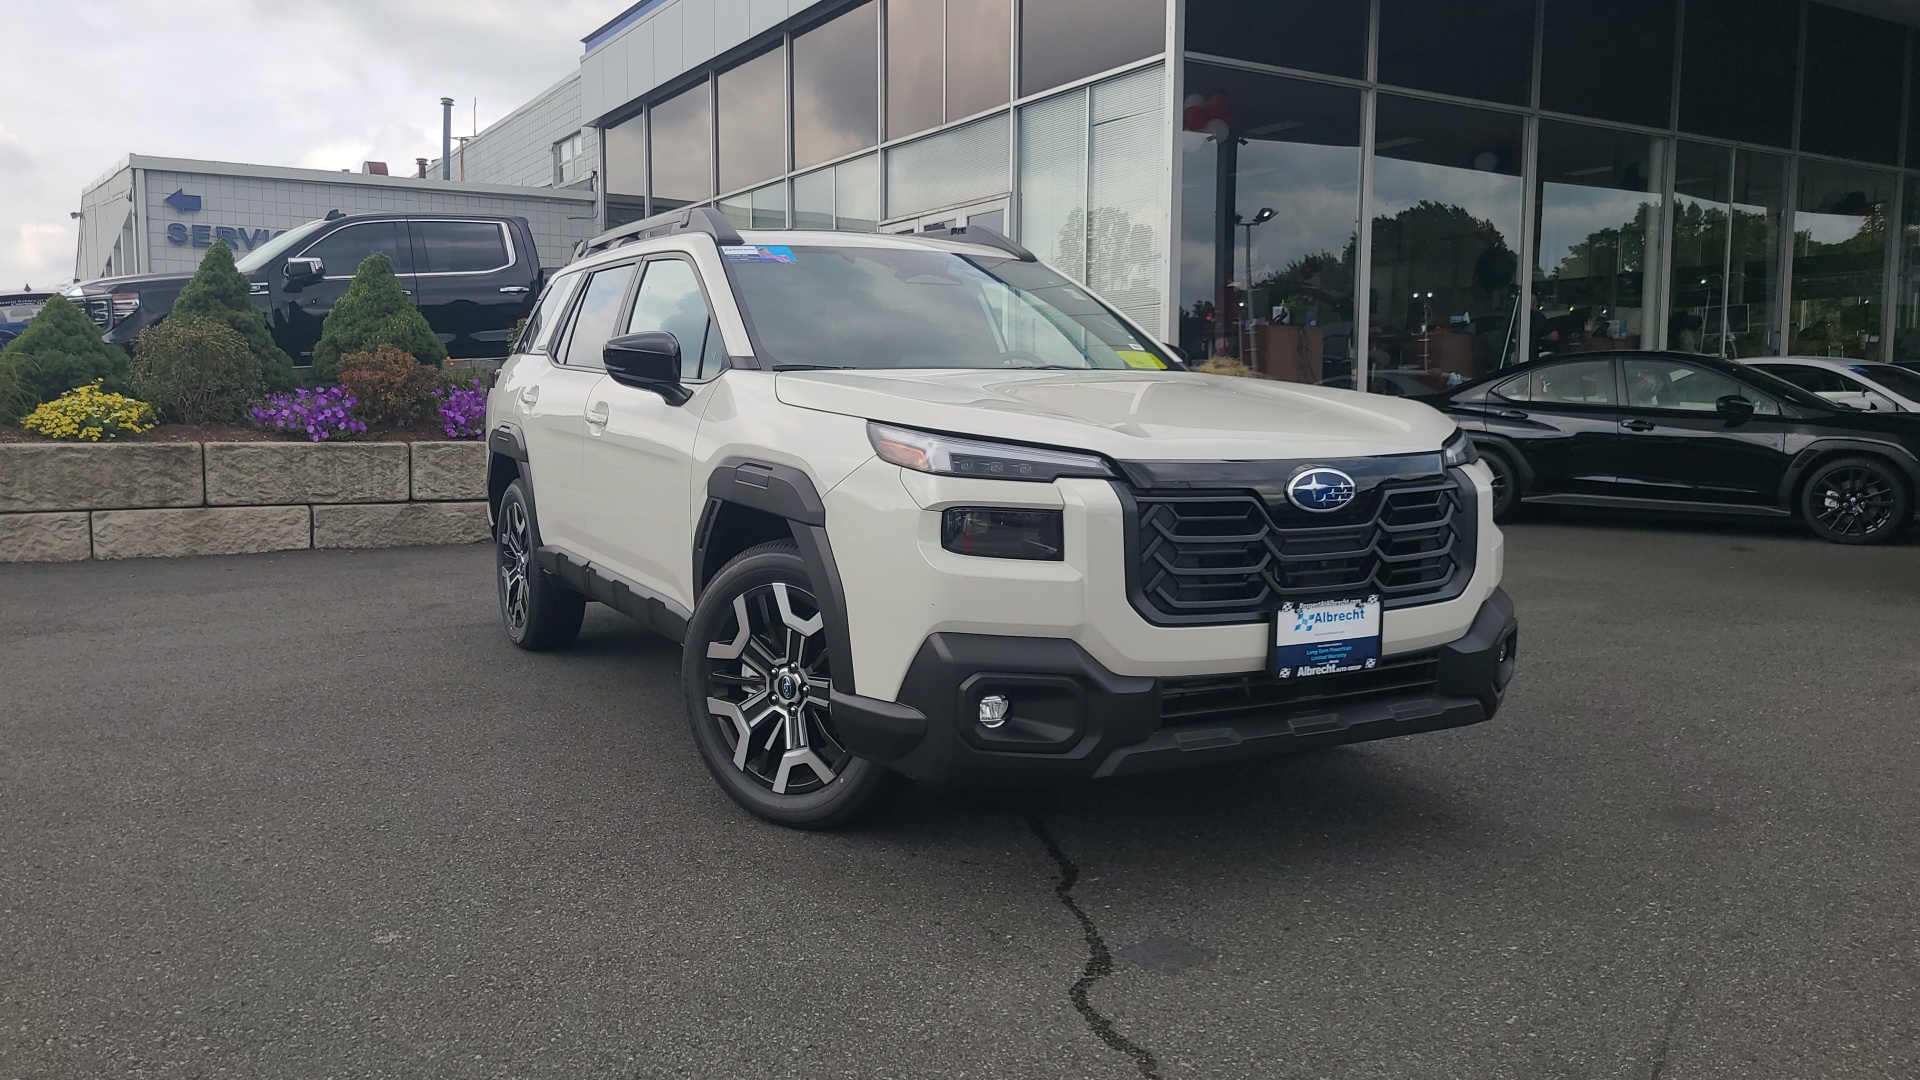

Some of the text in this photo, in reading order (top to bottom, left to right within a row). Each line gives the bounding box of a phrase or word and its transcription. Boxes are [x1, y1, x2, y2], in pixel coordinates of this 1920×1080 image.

[167, 223, 287, 250] SERVI
[1314, 609, 1365, 624] Albrecht
[1297, 663, 1336, 677] Albrecht
